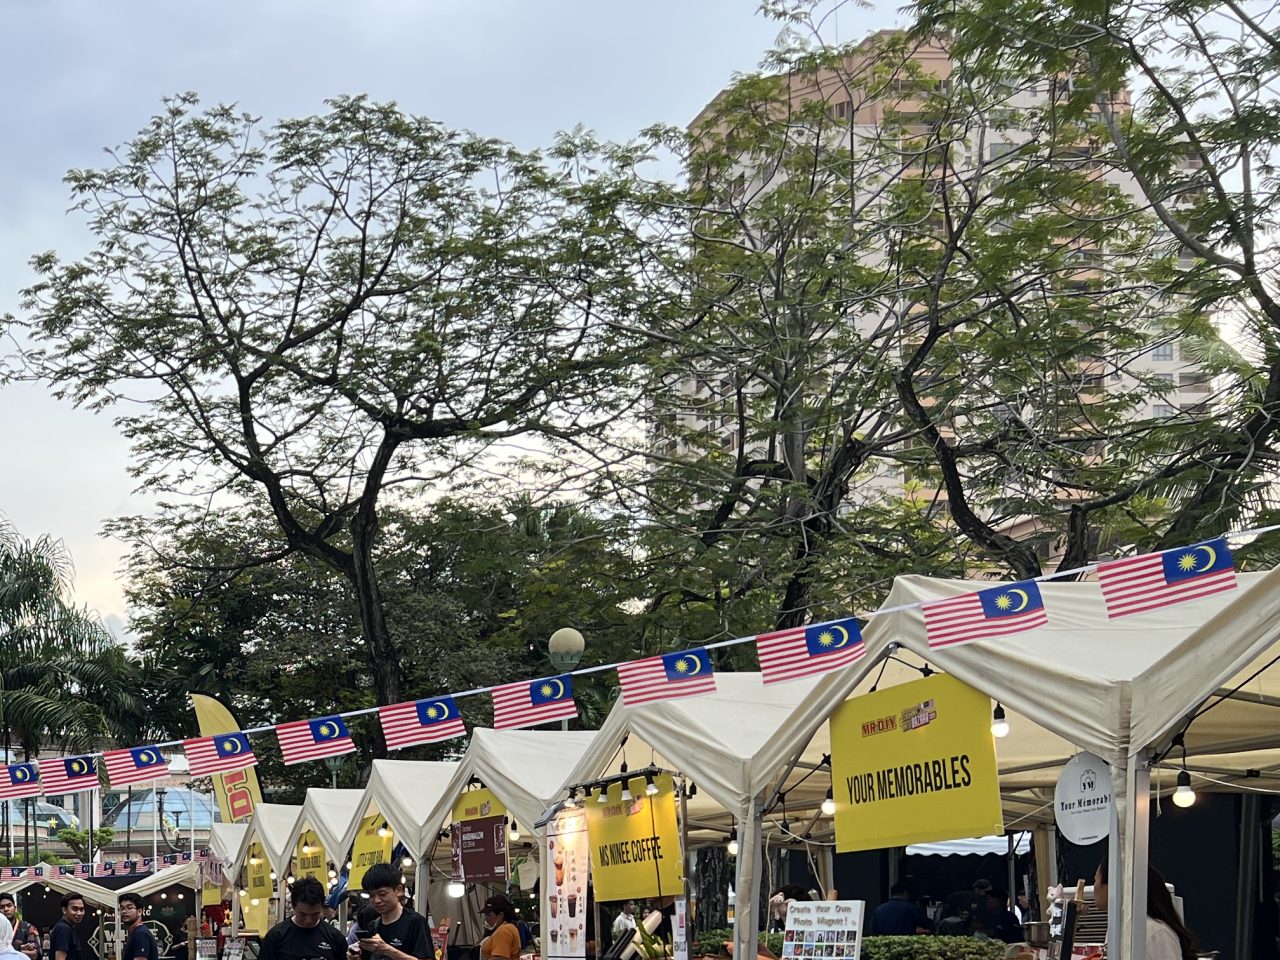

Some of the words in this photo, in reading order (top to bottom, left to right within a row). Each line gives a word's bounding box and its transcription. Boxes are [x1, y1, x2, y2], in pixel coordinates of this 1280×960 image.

[847, 773, 875, 805] YOUR
[876, 754, 972, 800] MEMORABLES
[599, 845, 609, 867] MS
[609, 841, 631, 866] NINEE
[631, 836, 663, 863] COFFEE
